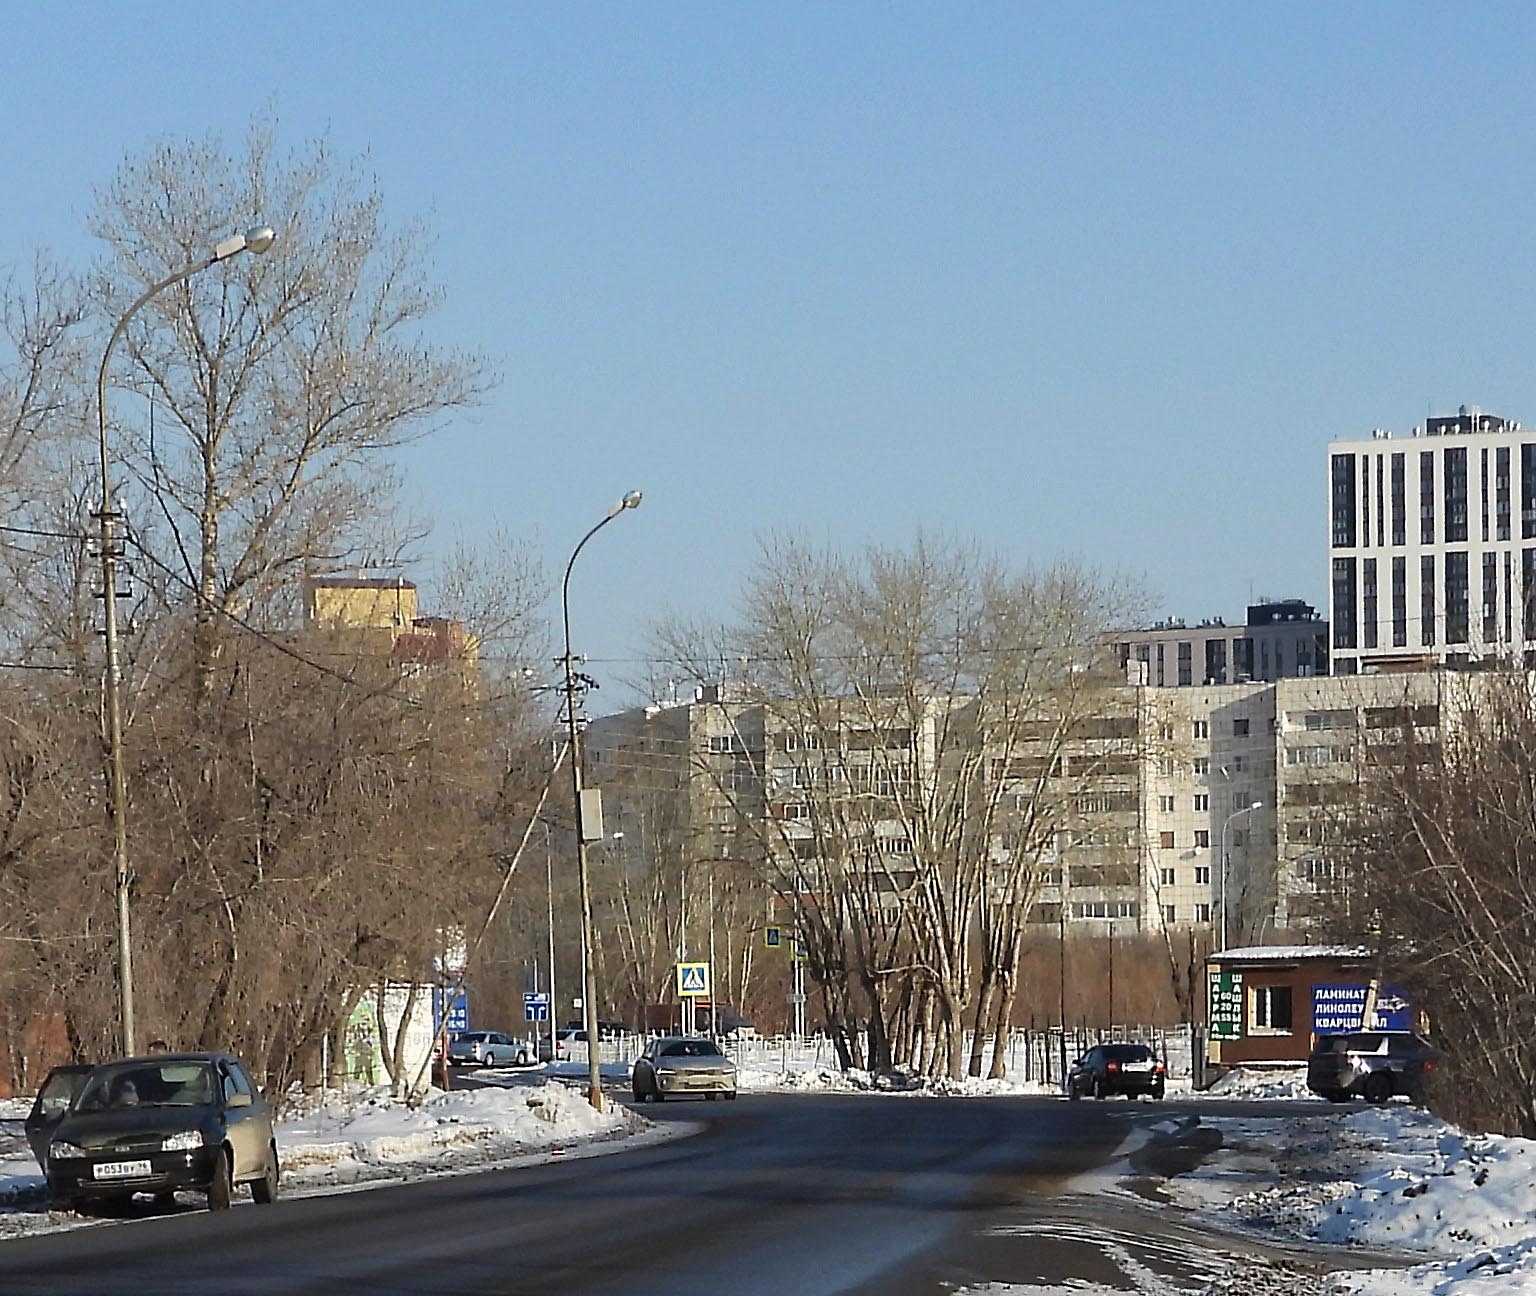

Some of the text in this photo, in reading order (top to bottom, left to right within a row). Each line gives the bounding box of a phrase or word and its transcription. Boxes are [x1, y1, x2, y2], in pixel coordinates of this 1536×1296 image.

[1211, 974, 1221, 1032] ШАУРМА
[1231, 974, 1242, 1032] ШАШЛЫК
[1315, 990, 1366, 999] ЛАМИНАТ
[1315, 1004, 1365, 1013] ЛИНОЛЕУ
